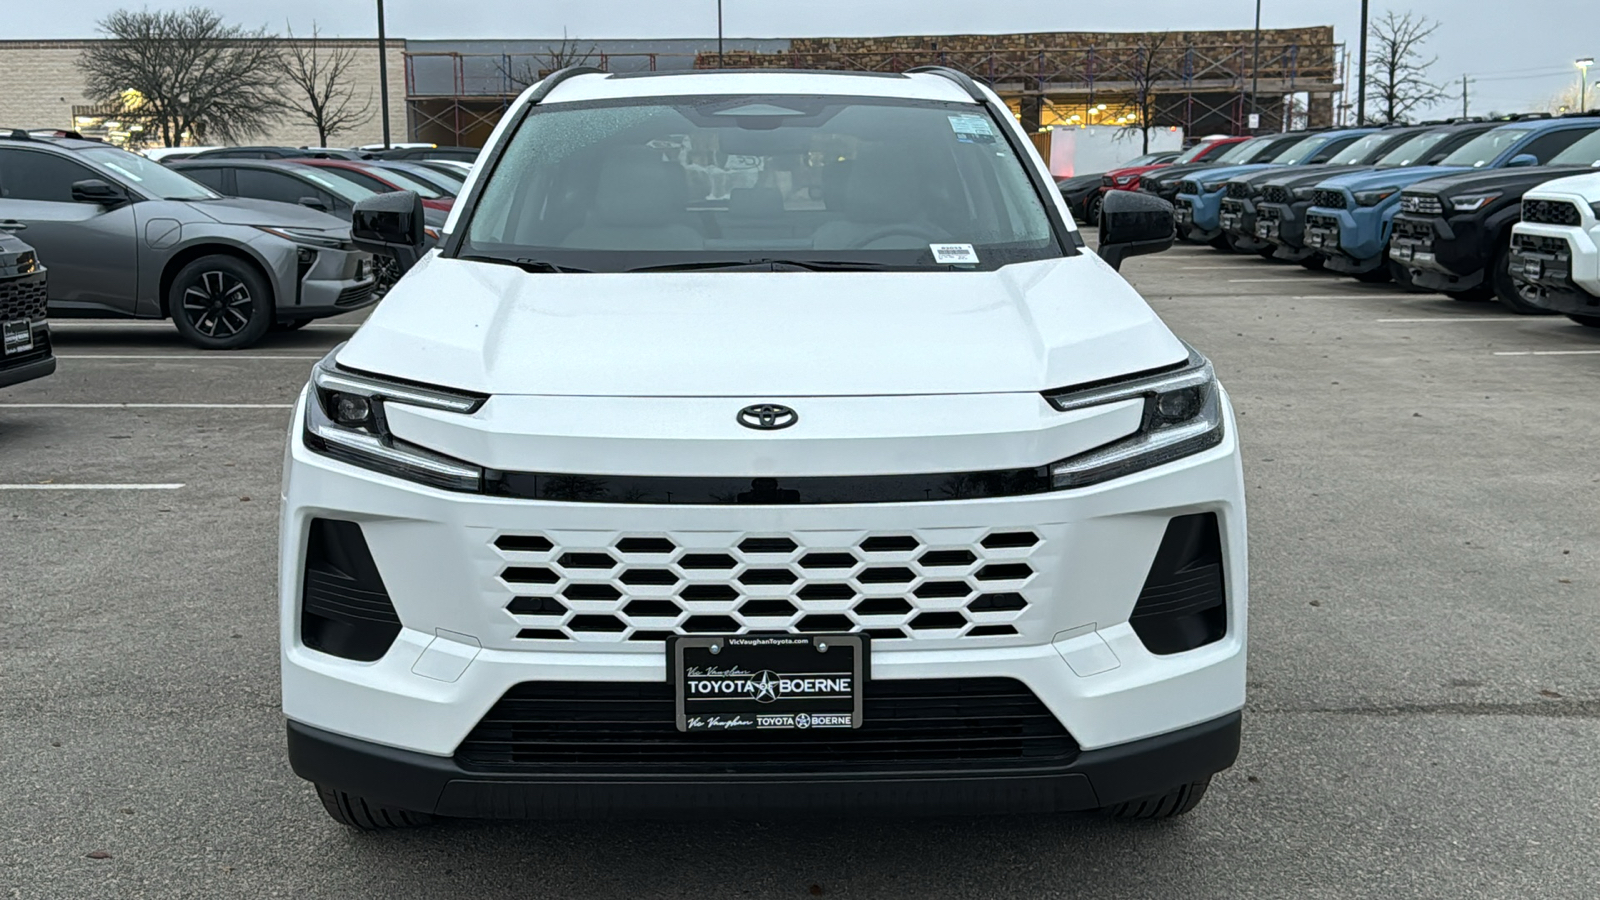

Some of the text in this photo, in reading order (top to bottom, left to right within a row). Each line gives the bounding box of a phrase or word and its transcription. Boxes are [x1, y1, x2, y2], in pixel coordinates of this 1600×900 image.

[729, 638, 809, 646] VicVaughanToyota.com
[686, 665, 750, 678] Vic Vaughan
[688, 680, 755, 693] TOYOTA
[779, 679, 851, 693] BOERNE
[687, 716, 705, 729] Vic
[707, 715, 753, 729] Vaughan
[757, 717, 795, 726] TOYOTA
[811, 716, 852, 725] BOERNE
